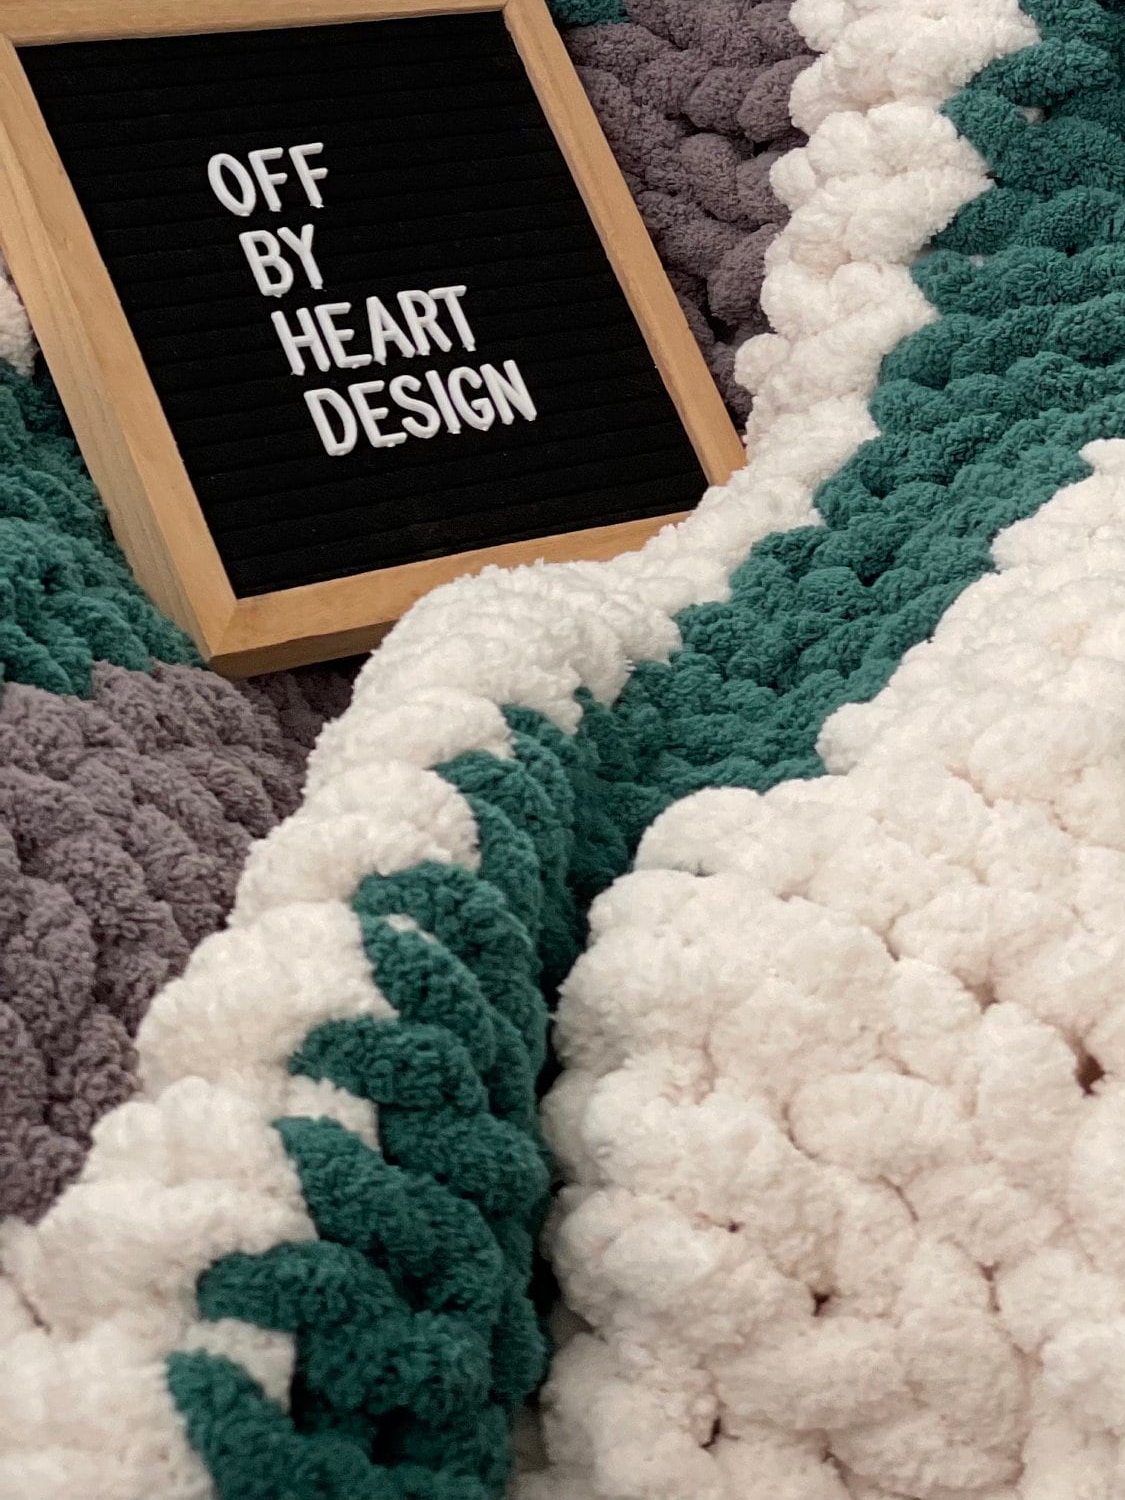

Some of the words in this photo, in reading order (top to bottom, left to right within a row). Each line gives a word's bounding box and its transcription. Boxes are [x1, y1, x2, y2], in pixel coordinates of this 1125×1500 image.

[208, 143, 328, 216] OFF
[239, 224, 323, 297] BY
[271, 285, 475, 375] HEART
[304, 360, 537, 455] DESIGN
